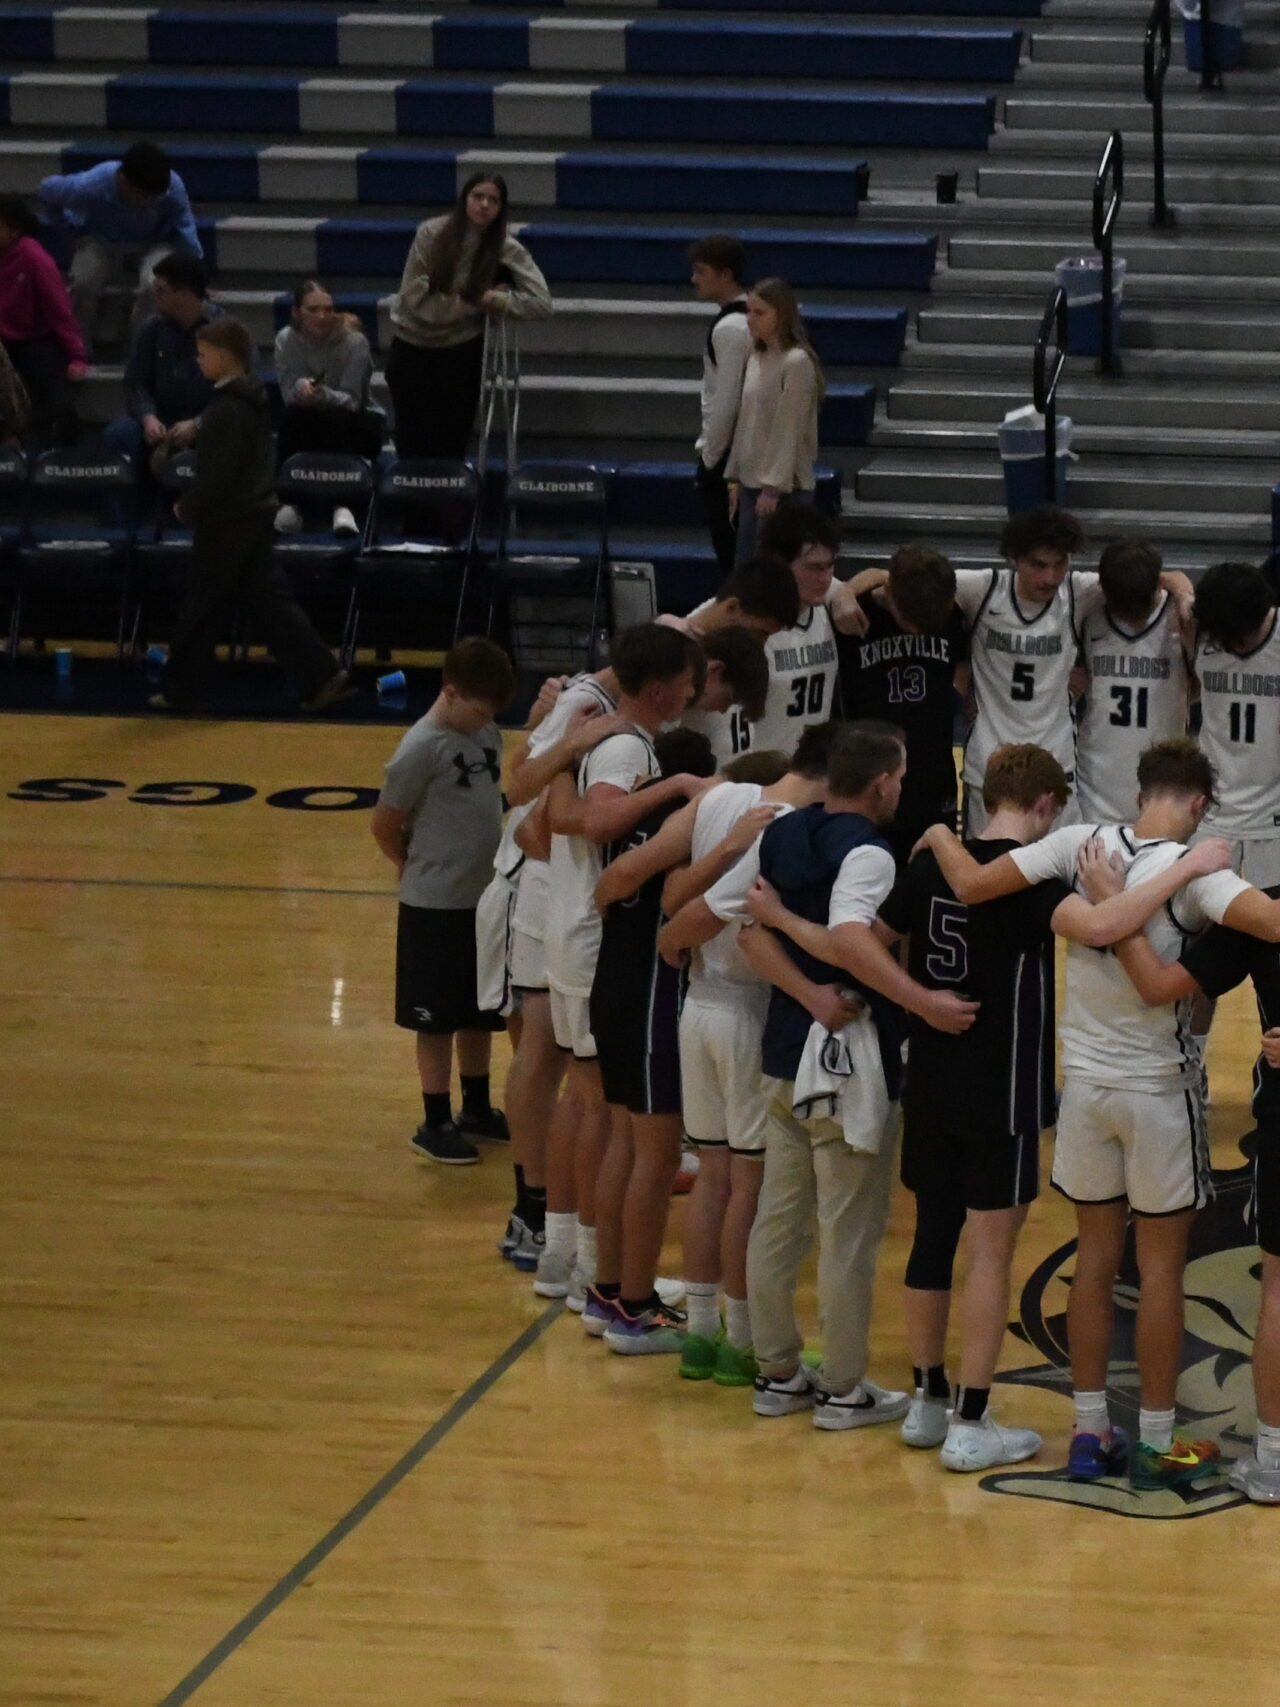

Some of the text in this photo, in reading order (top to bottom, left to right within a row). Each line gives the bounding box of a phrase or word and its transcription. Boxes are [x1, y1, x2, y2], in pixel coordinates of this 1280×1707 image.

[44, 464, 121, 478] CLAIBORNE
[290, 468, 362, 483] CLAIBORNE
[393, 474, 466, 489] CLAIBORNE
[519, 480, 595, 493] CLAIBORNE
[859, 633, 950, 669] KNOXVILLE
[1093, 655, 1171, 680] BULLDOGS
[787, 672, 826, 718] 30
[887, 664, 927, 704] 13
[1011, 662, 1034, 701] 5
[1110, 686, 1149, 728] 31
[1230, 702, 1256, 743] 11
[926, 896, 968, 982] 5
